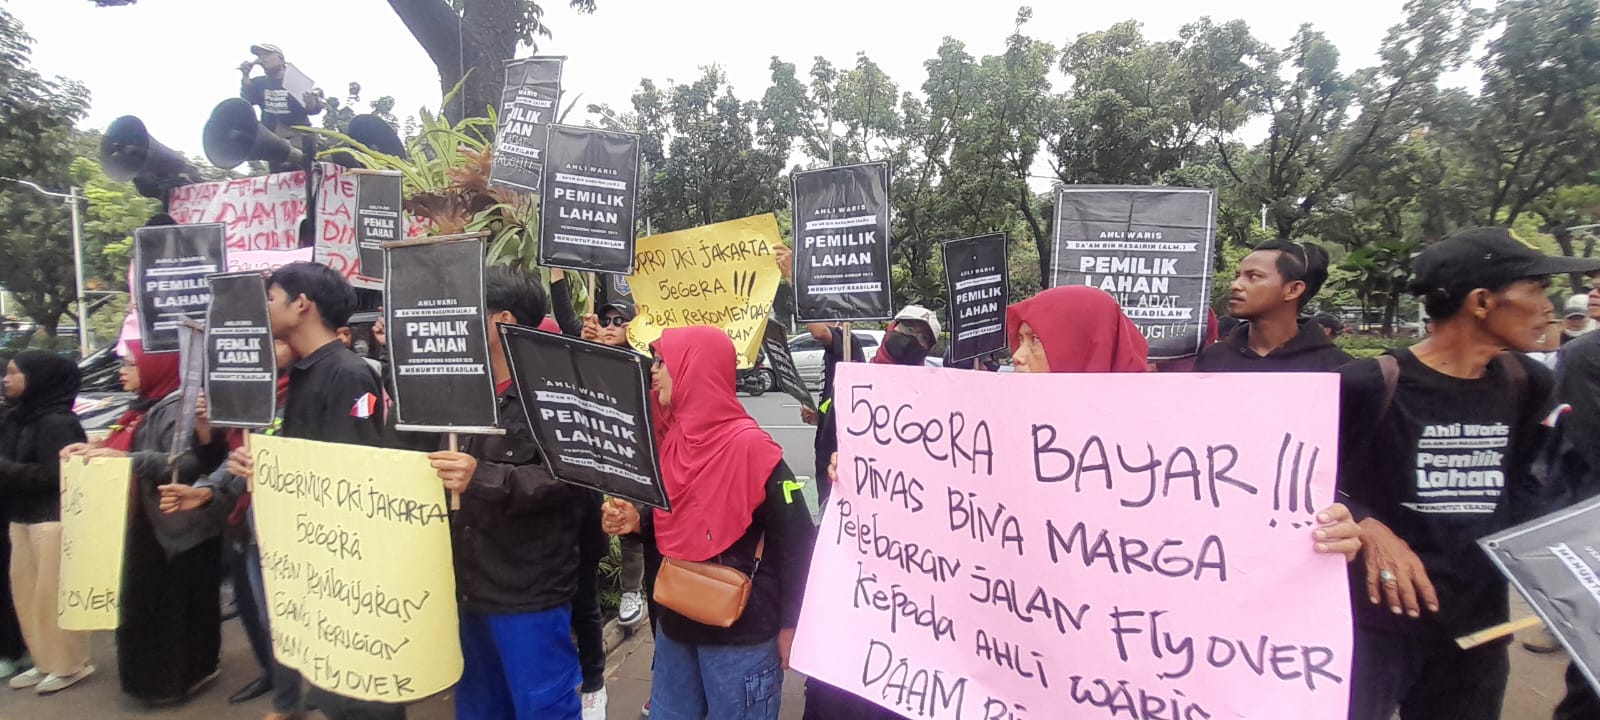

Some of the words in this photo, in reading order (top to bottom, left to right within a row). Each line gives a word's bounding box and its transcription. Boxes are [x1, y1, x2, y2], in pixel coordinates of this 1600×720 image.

[566, 163, 587, 171] AHLI
[590, 166, 618, 176] WARIS
[554, 187, 625, 207] PEMILIK
[559, 206, 618, 224] LAHAN
[815, 208, 836, 216] AHLI
[838, 205, 866, 213] WARIS
[805, 230, 876, 249] PEMILIK
[1100, 231, 1124, 239] AHLI
[1127, 231, 1162, 239] WARIS
[811, 252, 872, 268] LAHAN
[1079, 256, 1178, 275] PEMILIK
[1085, 275, 1169, 294] LAHAN
[154, 293, 212, 308] LAHAN
[956, 286, 1002, 305] PEMILIK
[960, 302, 998, 319] LAHAN
[1127, 309, 1183, 318] KEADILAN
[406, 320, 469, 337] PEMILIK
[1137, 322, 1166, 339] UGI
[412, 337, 467, 354] LAHAN
[546, 379, 576, 391] AHLI
[578, 386, 618, 405] WARIS
[540, 407, 638, 444] PEMILIK
[1422, 422, 1461, 437] Ahli
[1463, 421, 1510, 437] Waris
[555, 429, 636, 459] LAHAN
[1031, 423, 1258, 508] BAYAR
[1416, 449, 1504, 468] Pemilik
[1416, 468, 1505, 489] Lahan
[1046, 519, 1227, 581] MARGA
[861, 638, 968, 720] DAAM
